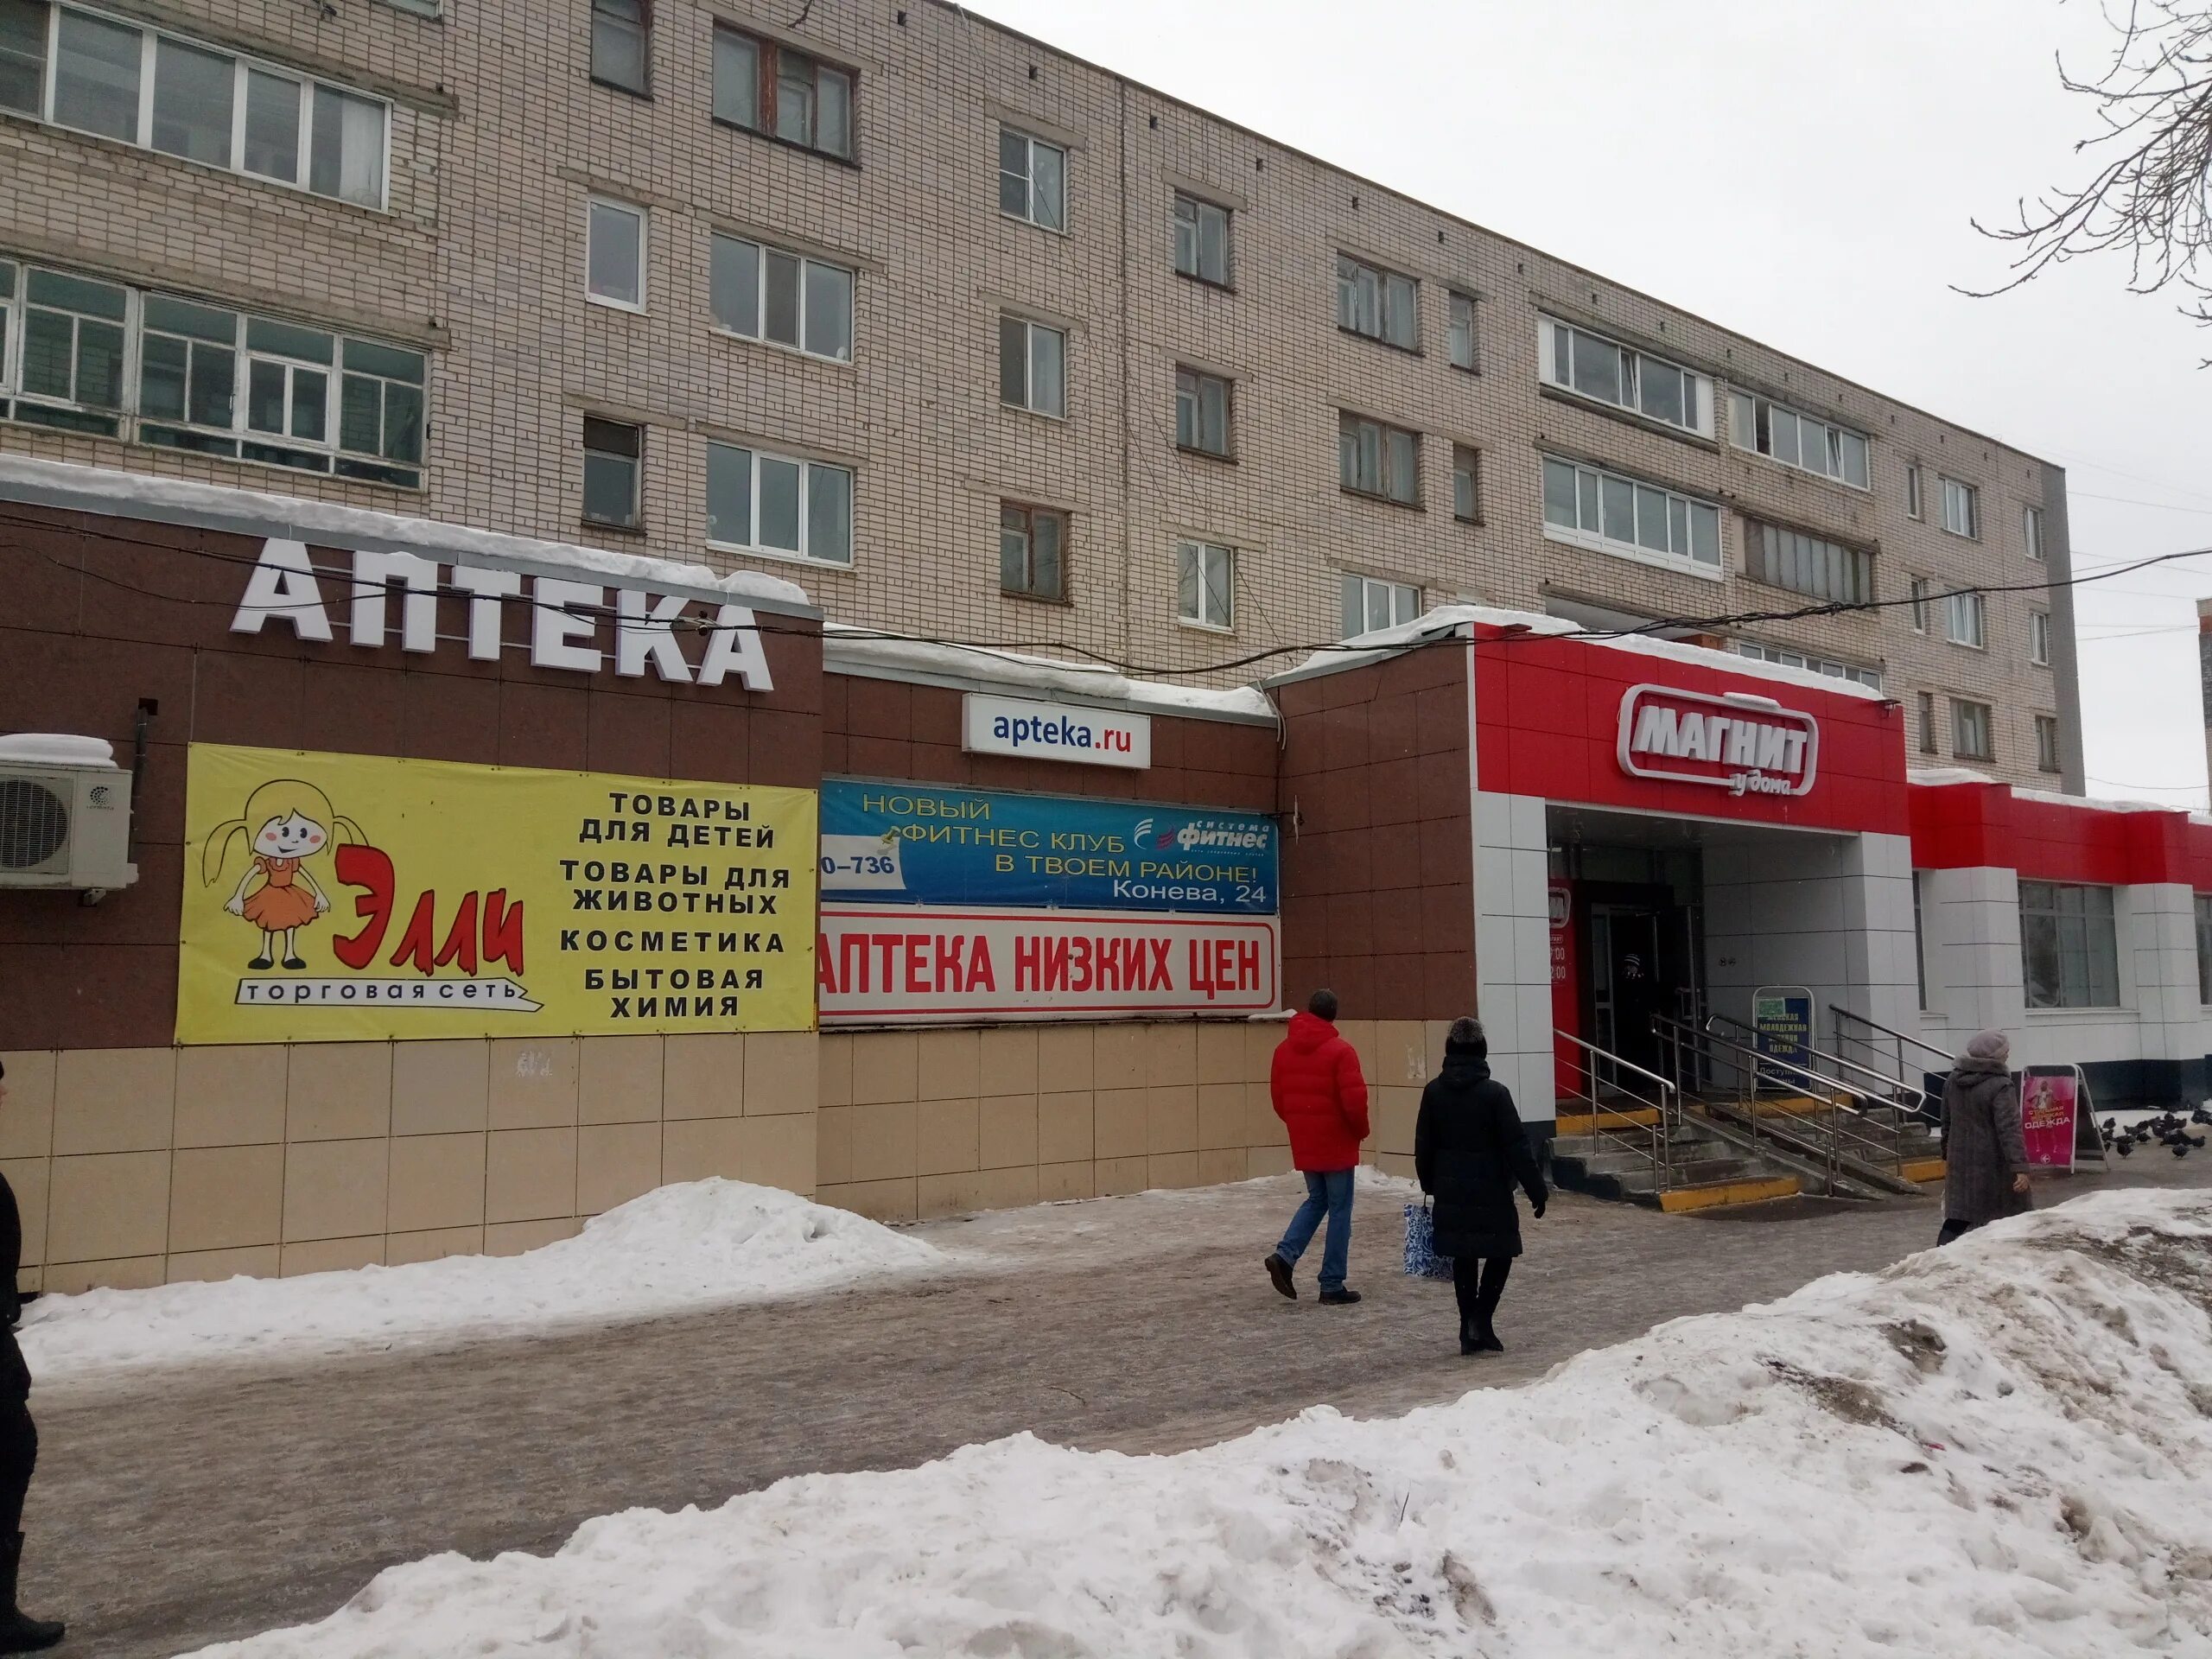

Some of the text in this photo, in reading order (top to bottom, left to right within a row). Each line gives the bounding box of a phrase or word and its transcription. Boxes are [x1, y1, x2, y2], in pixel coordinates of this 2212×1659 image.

[230, 537, 774, 692] АПТЕКА
[993, 713, 1132, 753] apteka.ru
[1631, 705, 1808, 774] МАГНИТ
[1745, 770, 1792, 796] дома
[610, 792, 751, 822] ТОВАРЫ
[862, 793, 991, 821] НОВЫЙ
[579, 818, 776, 850] ДЛЯ ДЕТЕЙ
[901, 823, 1126, 854] ФИТНЕС КЛУБ
[1177, 823, 1268, 851] фитнес
[1197, 820, 1270, 832] система
[560, 860, 791, 893] ТОВАРЫ ДЛЯ
[995, 854, 1257, 883] В ТВОЕМ РАЙОНЕ!
[573, 887, 779, 916] ЖИВОТНЫХ
[1113, 880, 1267, 903] Конева, 24
[332, 844, 525, 977] Элли
[561, 929, 785, 955] КОСМЕТИКА
[585, 967, 764, 993] БЫТОВАЯ
[1015, 936, 1173, 993] НИЗКИХ
[1189, 940, 1260, 1001] ЦЕН
[247, 982, 518, 1007] торговая сеть
[610, 995, 740, 1020] ХИМИЯ
[2024, 1117, 2071, 1129] ОДЕЖДА
